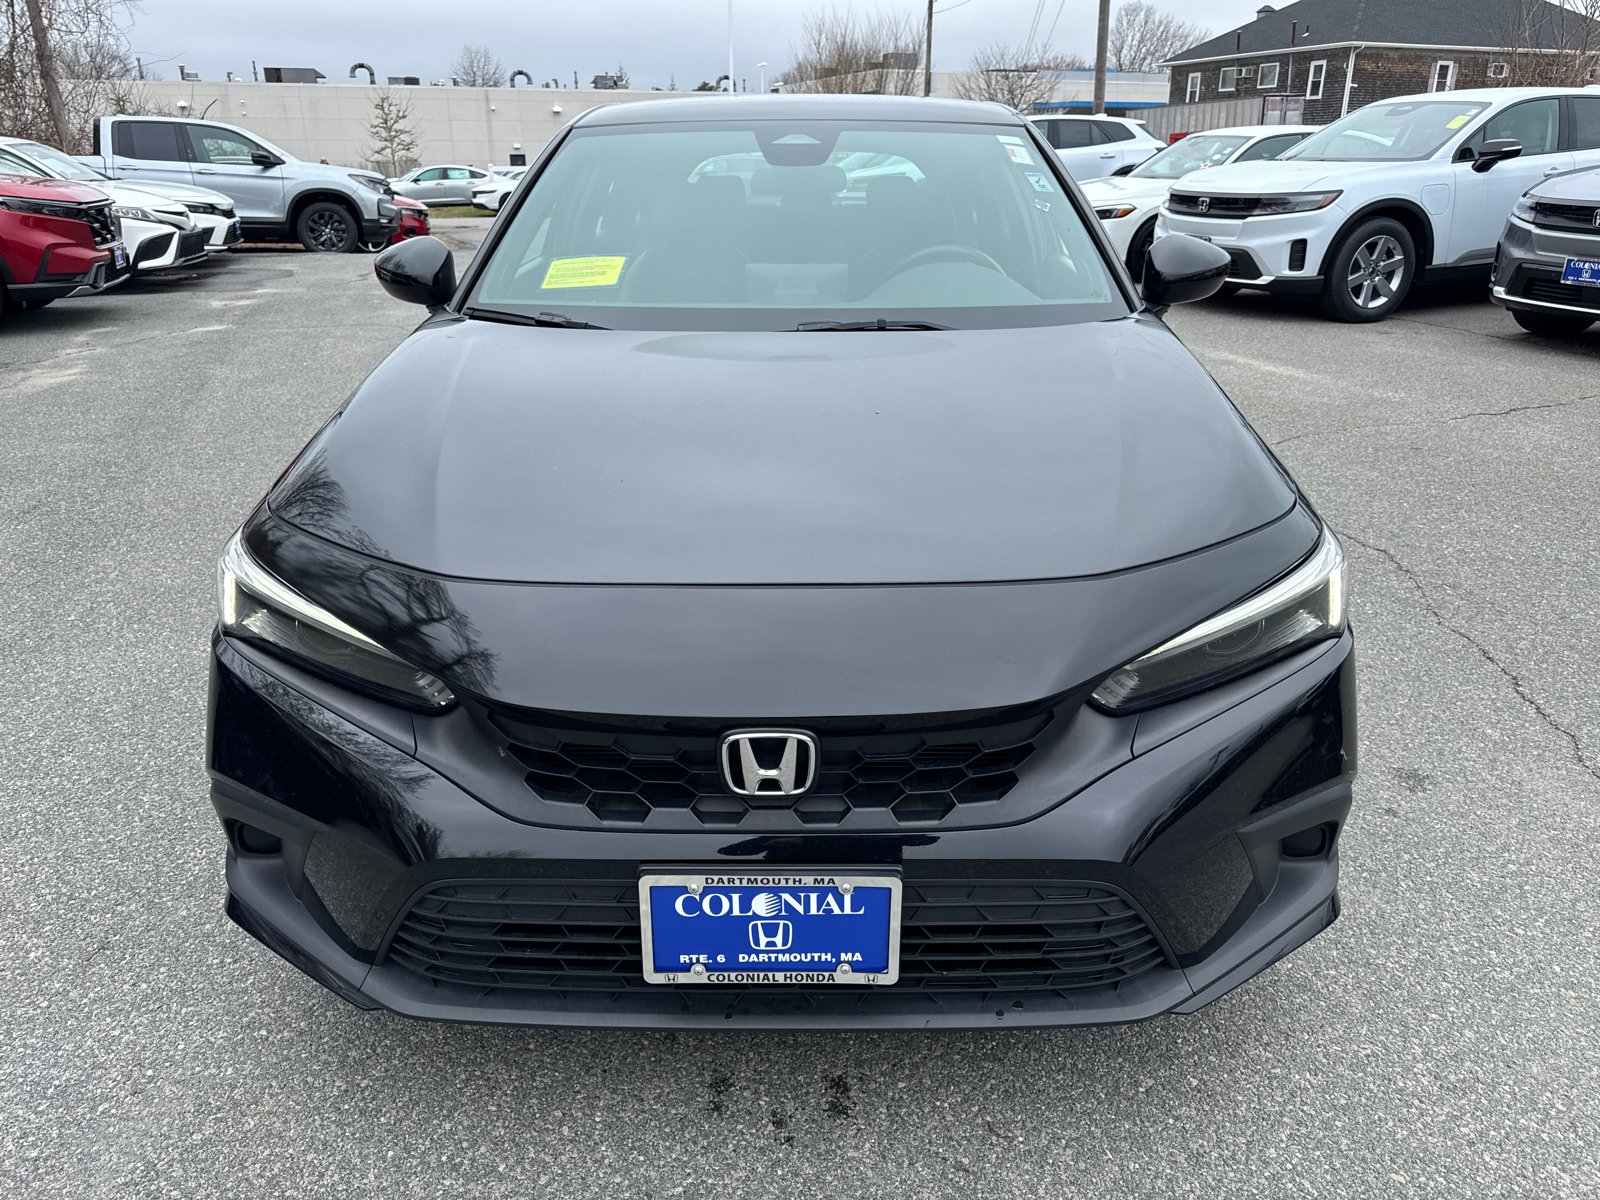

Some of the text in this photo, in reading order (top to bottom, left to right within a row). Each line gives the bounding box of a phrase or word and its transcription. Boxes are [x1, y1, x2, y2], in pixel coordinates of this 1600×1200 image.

[704, 877, 836, 886] DARTMOUTH, MA
[674, 892, 865, 917] COLONIAL
[679, 952, 863, 964] RTE. 6 DARTMOUTH, MA
[707, 973, 836, 983] COLONIAL HONDA
